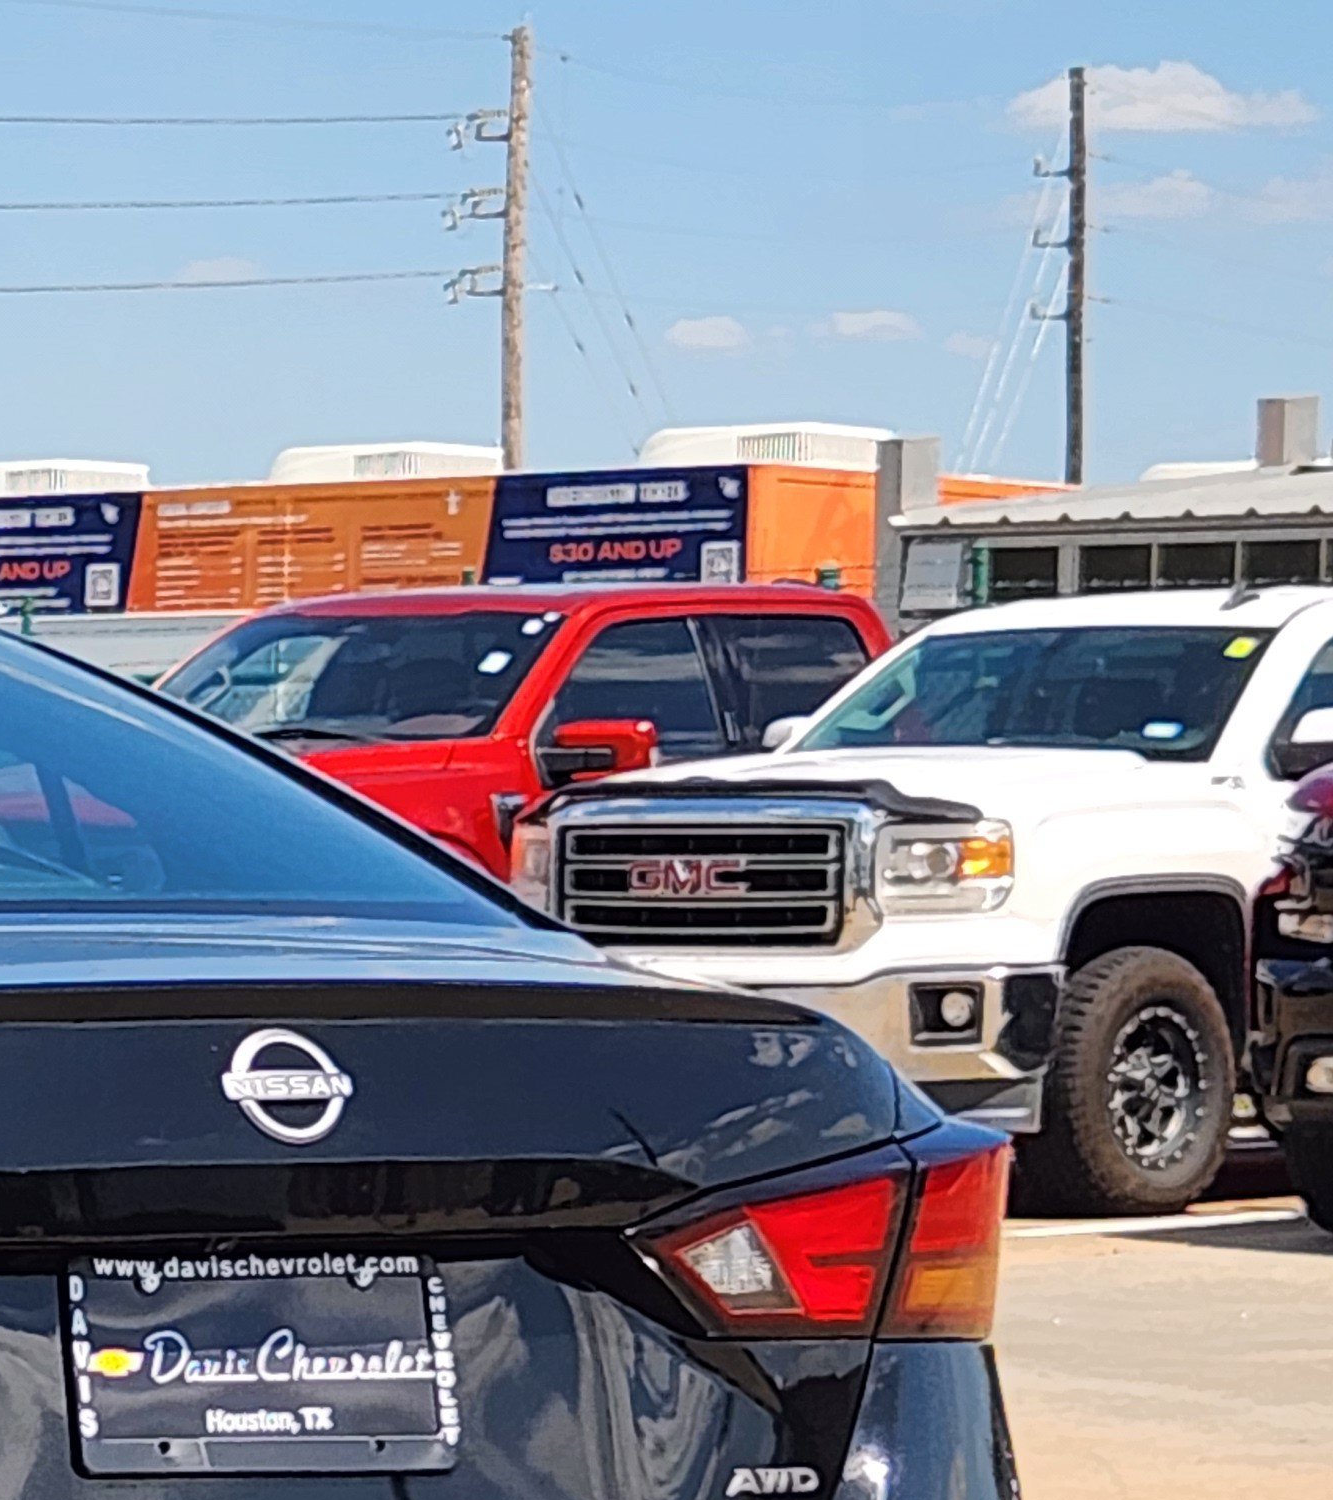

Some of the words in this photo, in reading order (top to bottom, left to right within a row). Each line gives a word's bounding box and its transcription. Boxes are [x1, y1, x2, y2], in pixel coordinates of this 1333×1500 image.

[597, 540, 646, 561] AND
[648, 538, 682, 559] UP
[43, 560, 72, 578] UP
[628, 859, 749, 896] GMC
[226, 1072, 352, 1099] NISSAN
[92, 1254, 420, 1278] www.davischevrolet.com
[68, 1275, 99, 1439] DAVIS
[143, 1329, 258, 1385] Davis
[256, 1327, 437, 1382] Chevrolet
[427, 1276, 462, 1446] CHEVROLET
[205, 1407, 301, 1435] Houston,
[297, 1405, 335, 1431] TX
[725, 1465, 820, 1498] AWD
